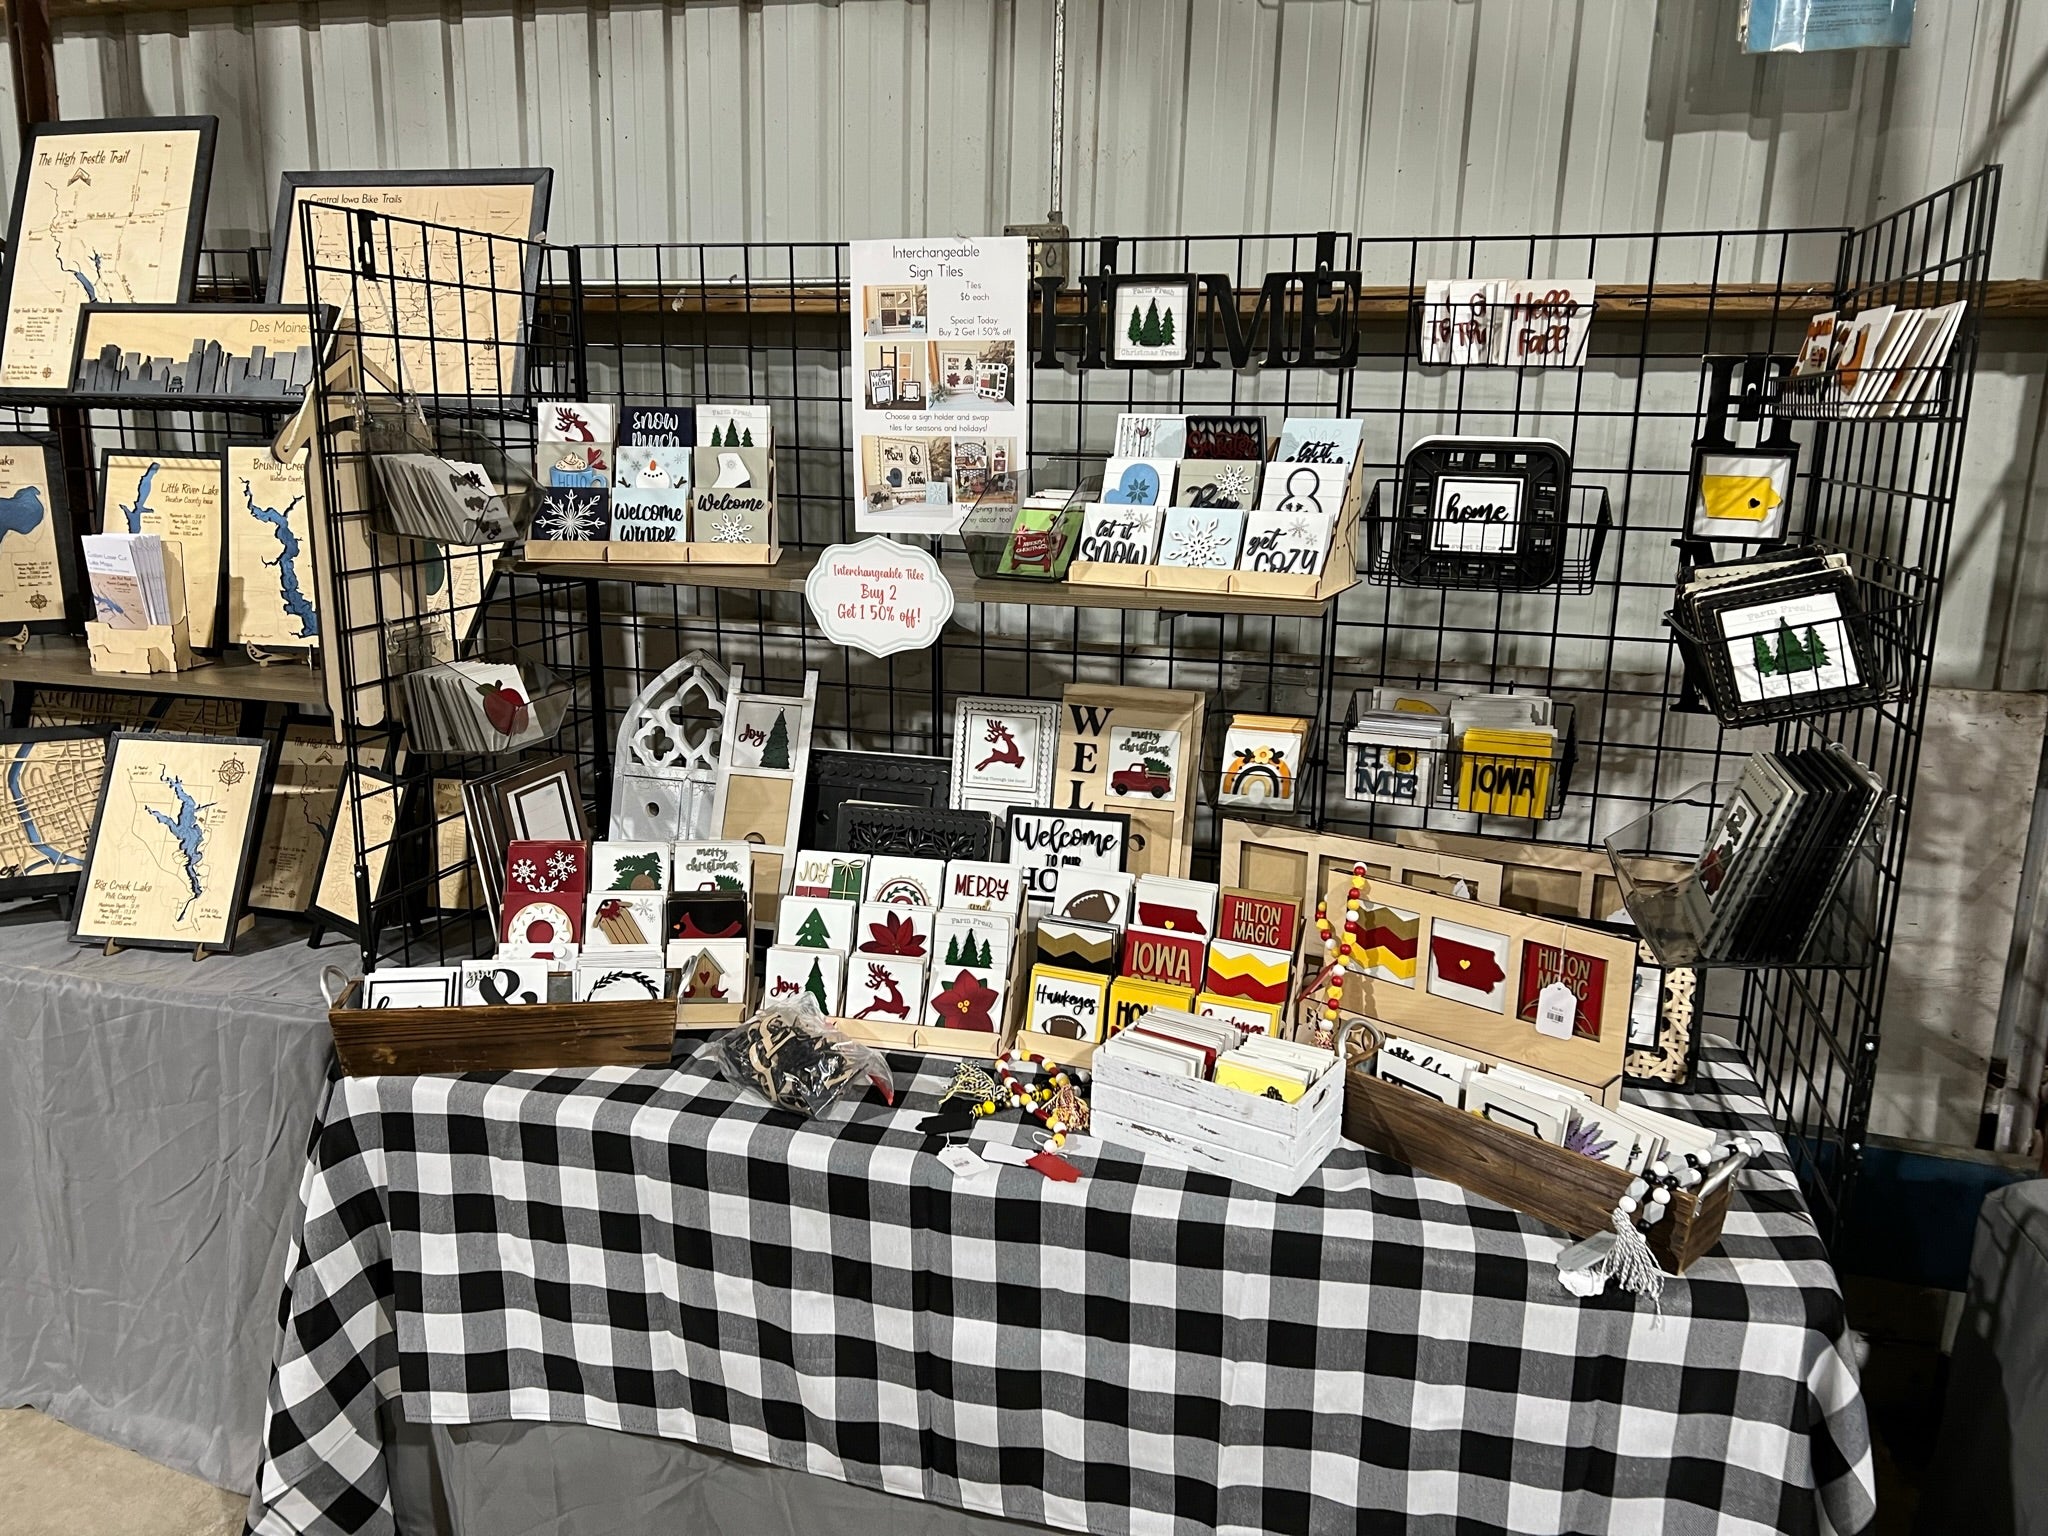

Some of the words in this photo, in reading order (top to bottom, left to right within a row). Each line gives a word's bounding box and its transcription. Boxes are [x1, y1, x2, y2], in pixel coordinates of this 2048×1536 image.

[38, 153, 52, 166] The
[55, 152, 76, 167] High
[79, 150, 106, 164] Trestle
[109, 149, 131, 164] Trail
[309, 194, 340, 204] Central
[341, 193, 359, 204] Iowa
[362, 193, 378, 204] Bike
[382, 193, 402, 204] Trails
[892, 245, 980, 260] Interchangeable
[909, 264, 933, 280] Sign
[937, 263, 964, 278] Tiles
[965, 280, 982, 289] Tiles
[960, 291, 971, 301] $6
[972, 293, 990, 301] each
[1512, 289, 1577, 322] Hello
[250, 319, 270, 333] Des
[273, 320, 311, 333] Moines
[950, 316, 974, 325] Special
[977, 316, 998, 326] Today
[938, 328, 951, 337] Buy
[955, 328, 959, 336] 2
[961, 328, 975, 336] Get
[983, 328, 1000, 336] 50%
[1002, 327, 1012, 336] off
[1517, 325, 1570, 357] Fall
[712, 408, 731, 417] Farm
[732, 408, 753, 417] Fresh
[885, 411, 910, 421] Choose
[919, 413, 932, 423] sign
[933, 412, 955, 421] holder
[957, 413, 970, 421] and
[972, 415, 990, 423] swap
[889, 424, 902, 432] tiles
[904, 424, 913, 432] for
[944, 424, 957, 432] and
[959, 424, 988, 433] holidays!
[253, 458, 283, 476] Brushy
[160, 482, 180, 494] Little
[181, 483, 200, 494] River
[202, 483, 219, 495] Lake
[558, 473, 587, 487] HELLO
[183, 496, 202, 507] County
[697, 492, 765, 512] Welcome
[1446, 493, 1509, 524] home
[1096, 519, 1116, 538] let
[1119, 521, 1140, 540] it
[1246, 528, 1287, 556] get
[833, 564, 903, 582] Interchangeable
[905, 568, 925, 581] Tiles
[860, 584, 884, 604] Buy
[889, 584, 897, 601] 2
[837, 603, 857, 620] Get
[860, 606, 865, 620] 1
[870, 605, 895, 622] 50%
[899, 607, 922, 629] off!
[1747, 608, 1778, 621] Farm
[1780, 603, 1813, 614] Fresh
[738, 723, 767, 747] Joy
[1130, 730, 1161, 745] merry
[1119, 739, 1171, 758] christmas
[1472, 763, 1536, 799] IOWA
[1015, 816, 1118, 858] Welcome
[696, 847, 728, 862] merry
[1045, 853, 1058, 867] TO
[686, 859, 740, 873] christmas
[799, 861, 830, 884] JOY
[94, 879, 108, 891] Big
[109, 880, 131, 891] Creek
[133, 881, 153, 892] Lake
[954, 873, 1010, 901] MERRY
[117, 892, 137, 903] County
[951, 917, 971, 925] Farm
[972, 917, 993, 928] Fresh
[1234, 901, 1282, 926] HILTON
[1233, 924, 1280, 947] MAGIC
[1132, 940, 1191, 982] IOWA
[1537, 948, 1591, 980] HILTON
[464, 968, 498, 988] you
[770, 975, 800, 997] Joy
[1035, 983, 1098, 1017] Hawkeyes
